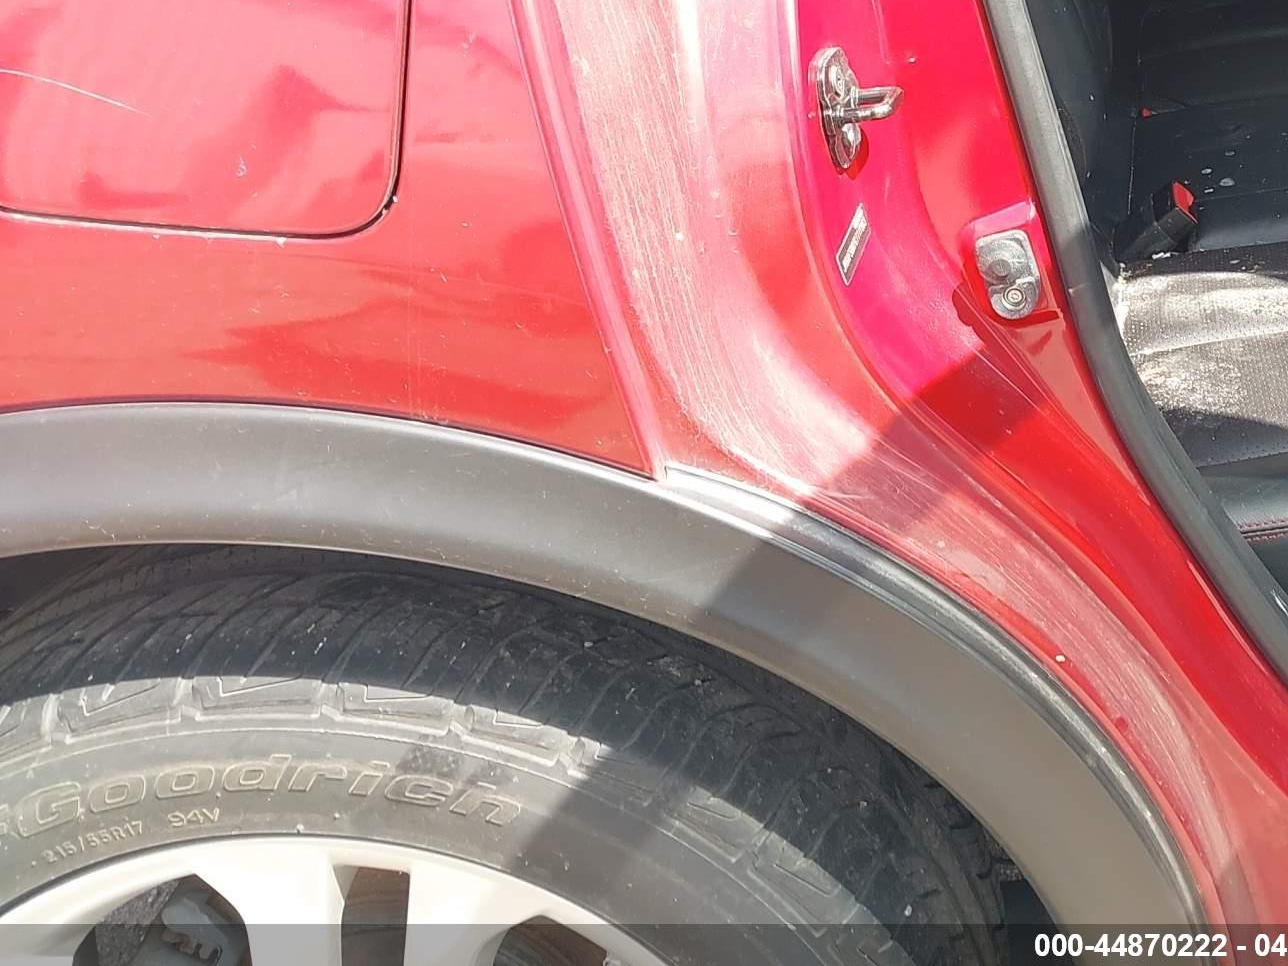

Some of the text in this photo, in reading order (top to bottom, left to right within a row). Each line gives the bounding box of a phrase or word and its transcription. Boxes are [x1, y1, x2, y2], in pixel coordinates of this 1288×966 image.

[0, 753, 522, 838] Goodrich
[41, 807, 221, 863] 215/55R17 94V
